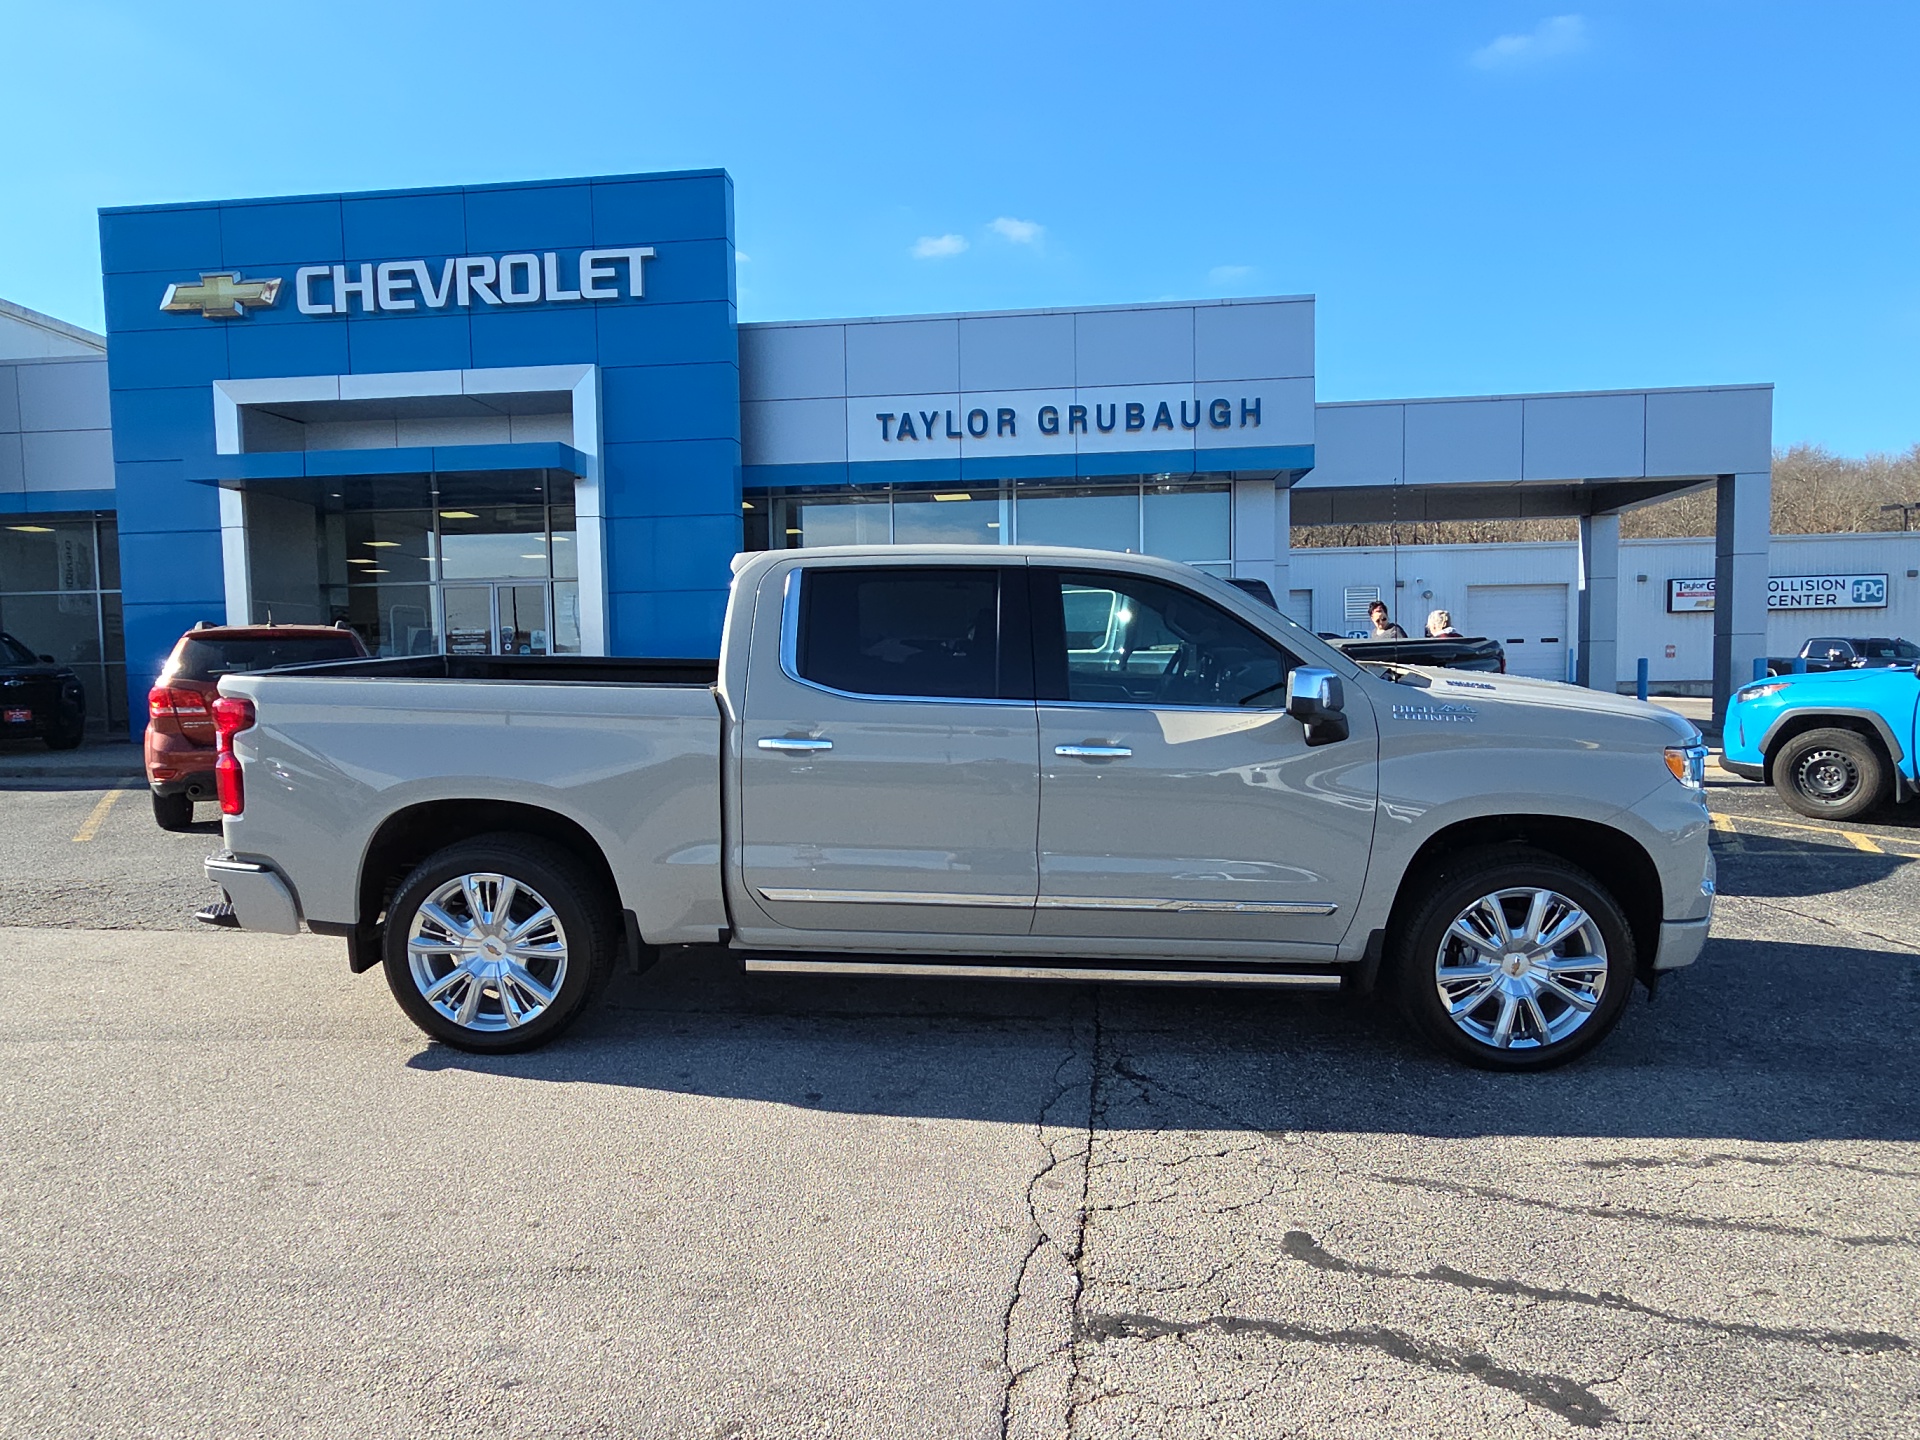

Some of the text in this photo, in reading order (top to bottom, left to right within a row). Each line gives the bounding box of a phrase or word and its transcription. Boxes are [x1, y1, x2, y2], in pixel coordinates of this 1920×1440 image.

[295, 246, 655, 315] CHEVROLET
[875, 397, 1263, 442] TAYLOR GRUBAUGH
[1676, 581, 1706, 592] Taylor
[1767, 579, 1846, 592] OLLISION
[1852, 581, 1884, 602] PPG
[1767, 593, 1837, 607] CENTER
